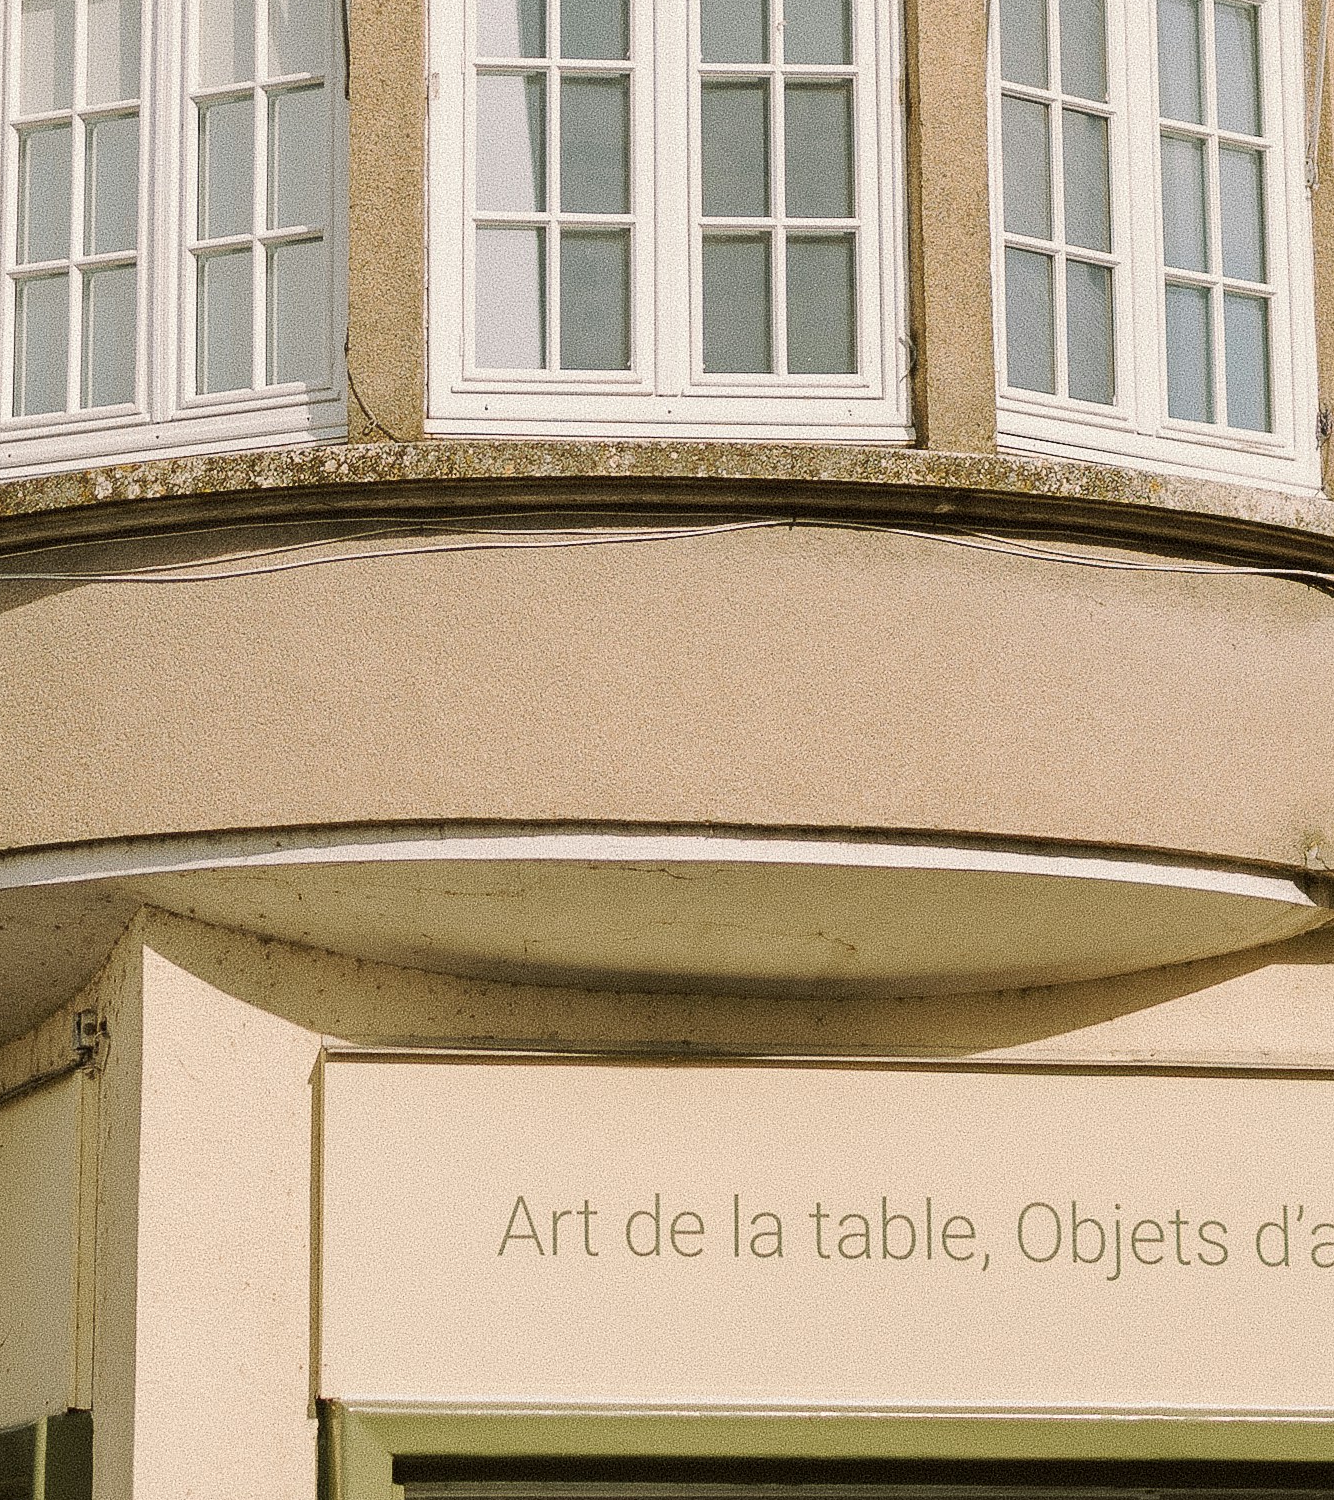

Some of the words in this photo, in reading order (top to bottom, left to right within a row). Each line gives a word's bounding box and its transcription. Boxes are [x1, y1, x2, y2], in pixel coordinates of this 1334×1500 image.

[497, 1195, 600, 1258] Art
[625, 1192, 706, 1259] de
[733, 1193, 784, 1260] la
[808, 1195, 991, 1272] table,
[1016, 1200, 1229, 1282] Objets
